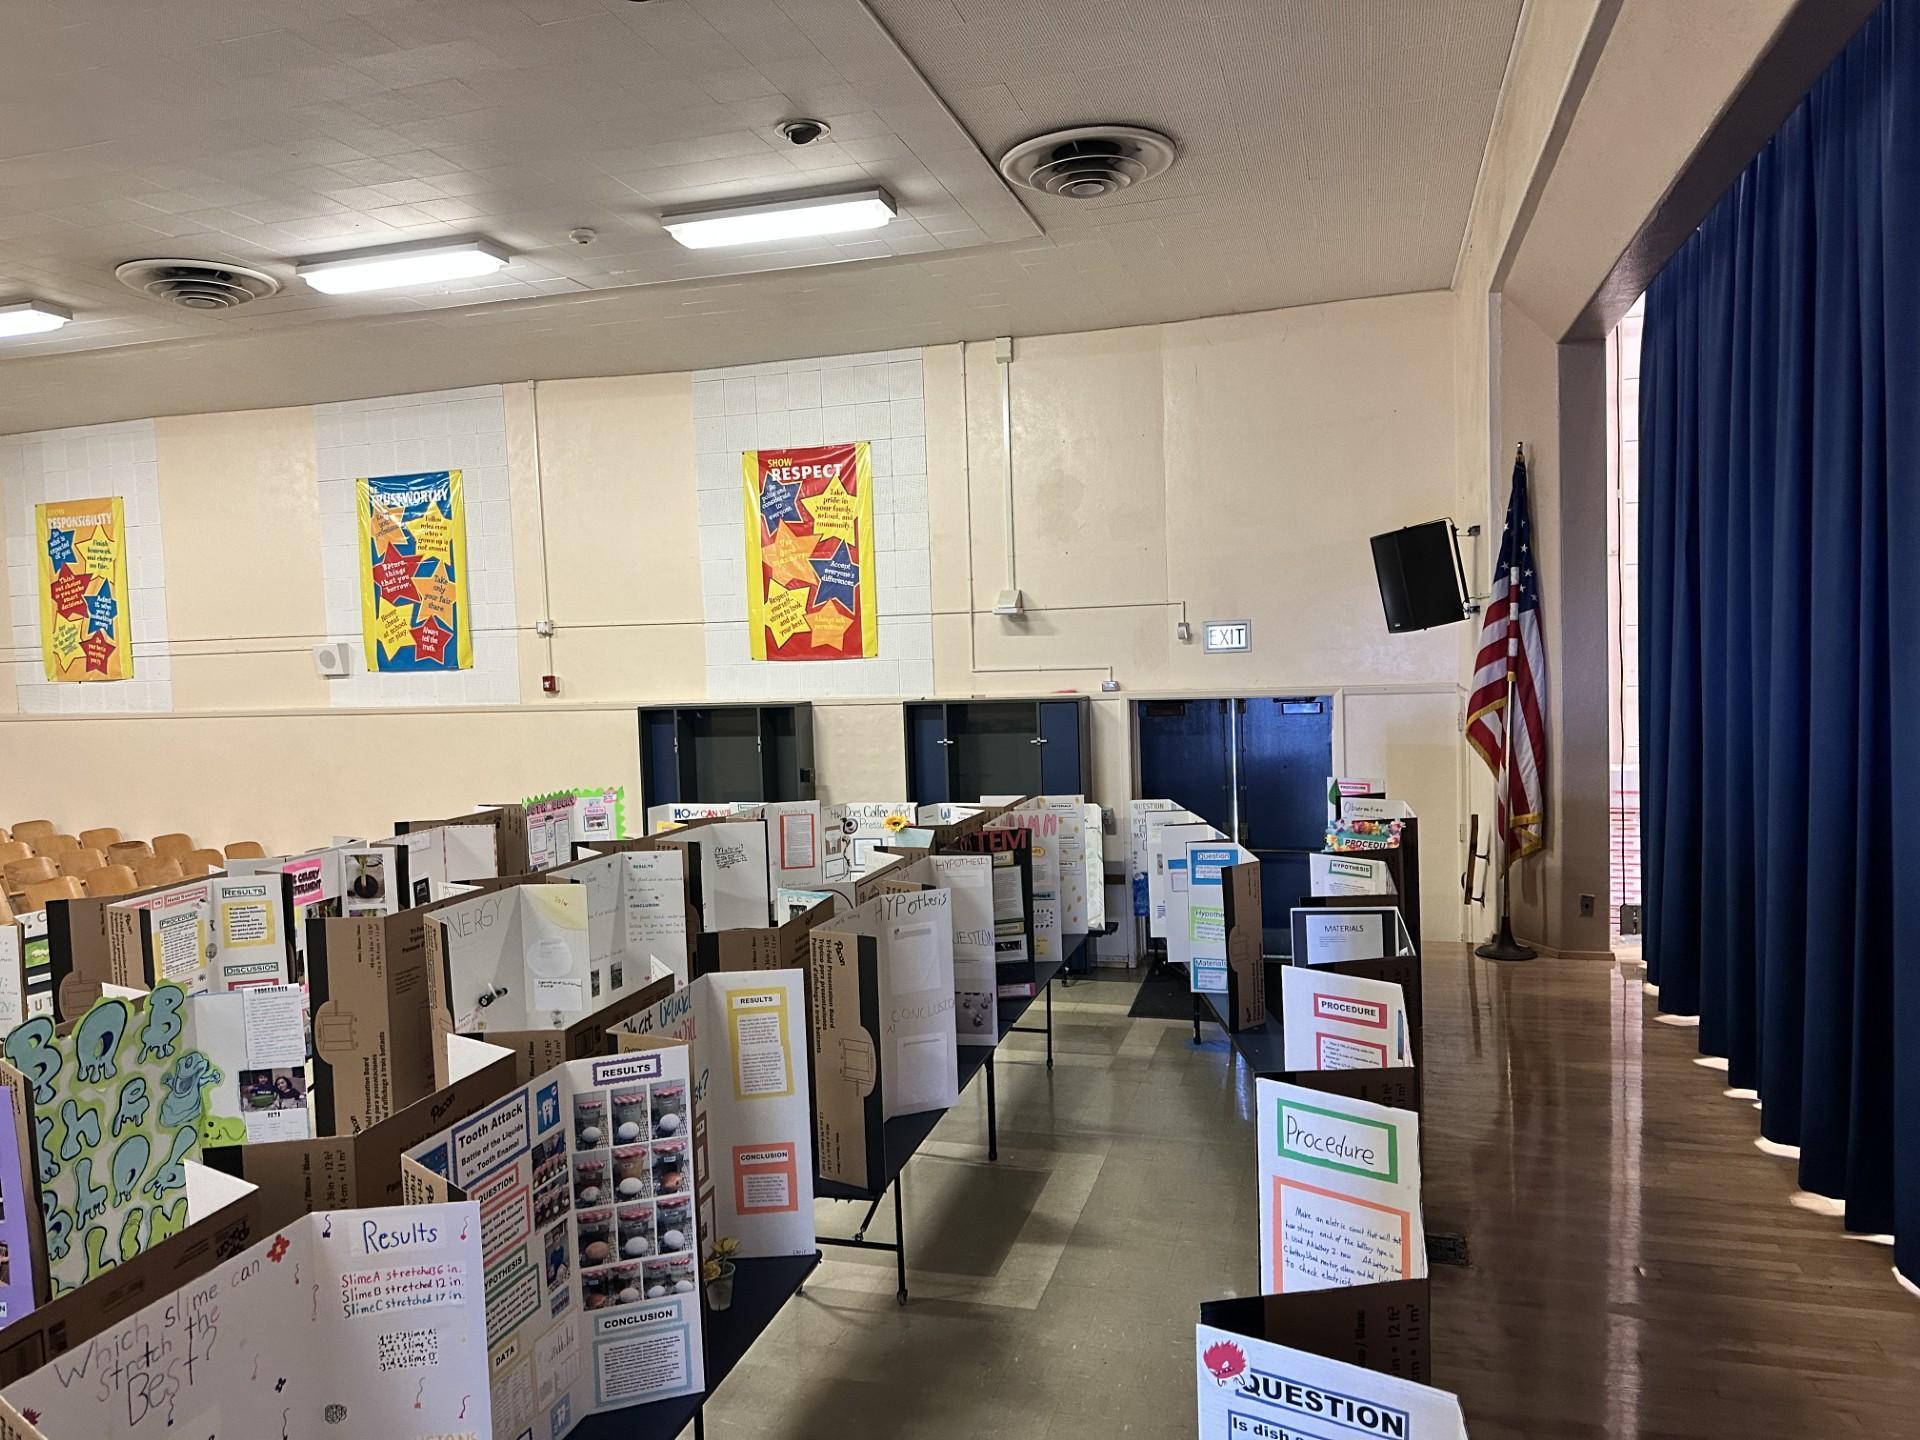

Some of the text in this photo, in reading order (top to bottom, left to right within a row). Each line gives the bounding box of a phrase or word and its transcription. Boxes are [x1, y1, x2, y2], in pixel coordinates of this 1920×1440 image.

[768, 458, 793, 468] SHOW
[772, 463, 843, 481] RESPECT
[823, 497, 840, 505] pride
[48, 512, 112, 528] RESPONSIBILITY
[830, 560, 851, 569] Accept
[386, 568, 406, 578] things
[434, 574, 448, 584] Take
[381, 575, 409, 587] that you
[433, 585, 446, 594] only
[439, 596, 451, 605] fair
[769, 591, 790, 605] Respect
[791, 602, 802, 612] look
[391, 619, 408, 634] school
[780, 618, 790, 627] and
[422, 626, 439, 637] Always
[780, 625, 792, 638] your
[1209, 628, 1244, 646] EXIT
[674, 808, 718, 819] HOW CAN
[864, 805, 888, 817] Coffee
[1345, 839, 1386, 850] PROCEDU
[936, 858, 989, 872] HYPOTHESIS
[1332, 863, 1370, 873] HYPOTHESIS
[298, 869, 319, 882] CELERY
[224, 888, 265, 897] RESULTS
[440, 897, 503, 941] NERGY
[1324, 925, 1364, 933] MATERIALS
[952, 931, 994, 946] UESTION
[226, 964, 277, 975] DISCUSSION
[740, 996, 773, 1004] RESULTS
[1321, 1000, 1376, 1016] PROCEDURE
[602, 1064, 651, 1078] RESULTS
[459, 1125, 488, 1148] Tooth
[491, 1103, 523, 1131] Attack
[462, 1123, 523, 1166] Battle of the Liquids
[1286, 1115, 1374, 1165] Procedure
[477, 1155, 495, 1169] Tooth
[497, 1139, 519, 1159] Enamel
[741, 1152, 787, 1160] CONCLUSION
[478, 1174, 514, 1202] QUESTION
[1296, 1206, 1312, 1219] Make
[362, 1220, 439, 1254] Results
[1320, 1232, 1333, 1240] each
[1335, 1235, 1341, 1243] of
[1344, 1238, 1354, 1246] the
[485, 1255, 523, 1289] YPOTHESIS
[1286, 1257, 1318, 1277] to check
[342, 1273, 374, 1288] Slime
[342, 1288, 374, 1304] Slime
[386, 1280, 433, 1294] stretched
[435, 1277, 446, 1289] 12
[449, 1278, 464, 1288] in.
[343, 1303, 375, 1319] Slime
[376, 1300, 383, 1311] C
[386, 1294, 432, 1309] stretched
[435, 1293, 446, 1302] 17
[54, 1259, 260, 1388] Which slime can
[184, 1304, 221, 1341] the
[604, 1310, 673, 1329] CONCLUSION
[495, 1345, 515, 1367] DATA
[1243, 1374, 1403, 1438] QUESTION
[1233, 1417, 1290, 1440] Is dish
